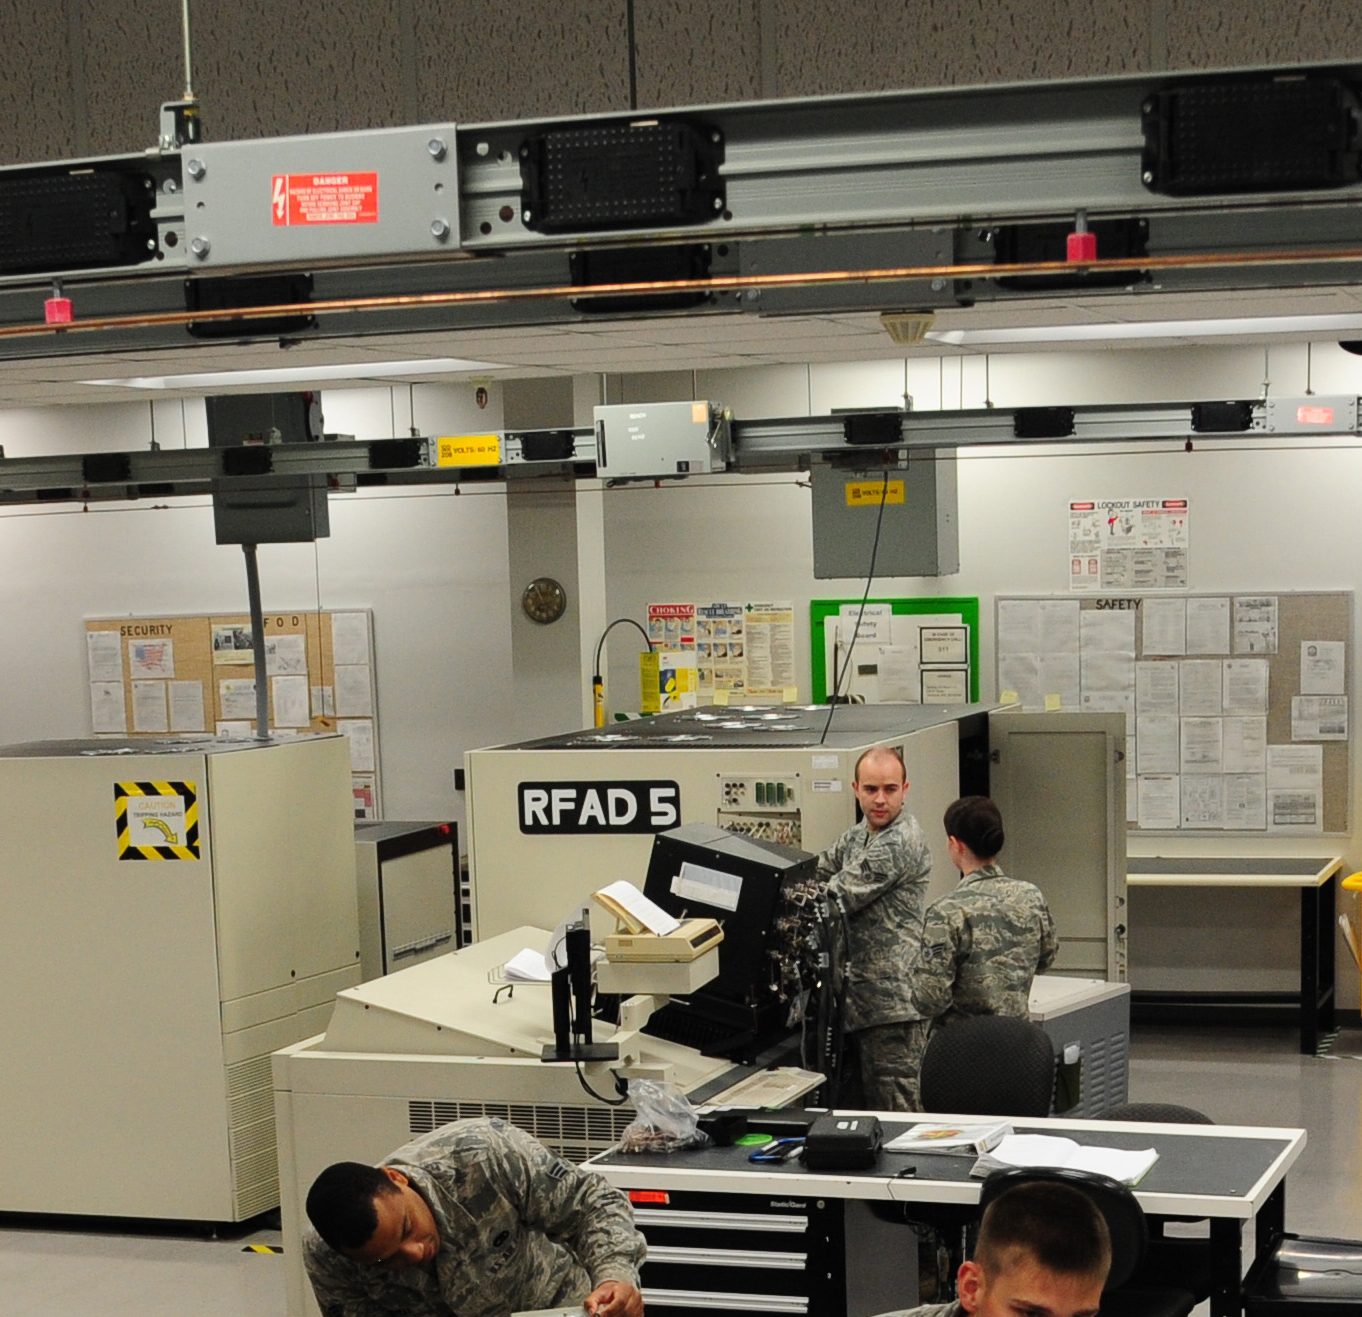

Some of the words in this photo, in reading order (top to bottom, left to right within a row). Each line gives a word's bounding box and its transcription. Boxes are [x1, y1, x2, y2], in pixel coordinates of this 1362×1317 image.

[313, 176, 349, 186] DANGER
[1097, 501, 1131, 509] LOCKOUT
[1133, 501, 1160, 509] SAFETY
[1095, 597, 1143, 610] SAFETY
[648, 605, 695, 615] CHOKING
[848, 605, 882, 616] Eletrical
[120, 624, 174, 637] SECURITY
[138, 801, 177, 809] CAUTION
[523, 788, 638, 826] RFAD
[649, 787, 677, 826] 5
